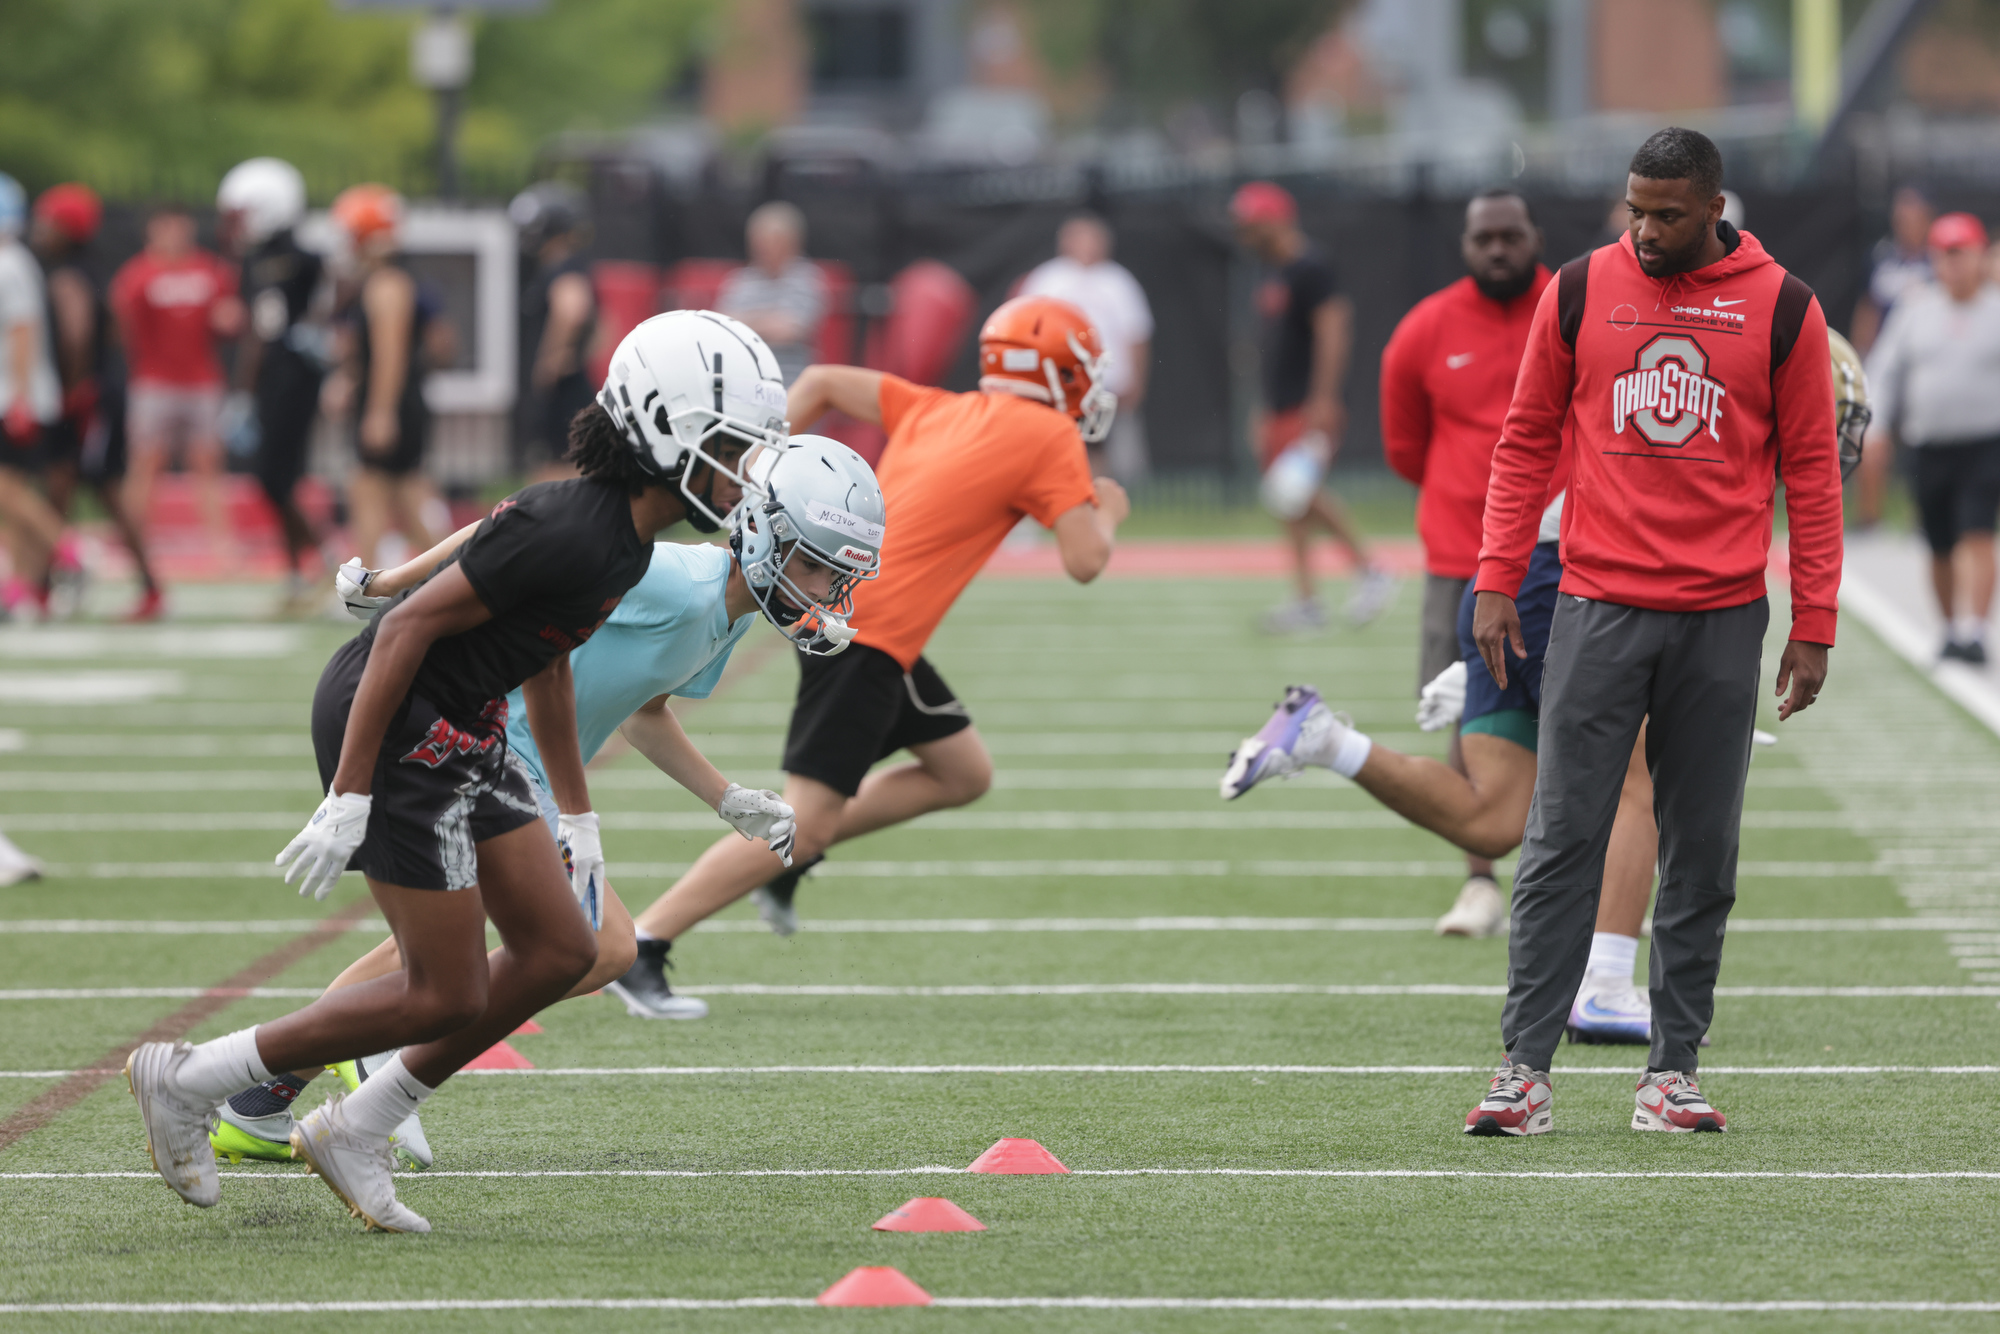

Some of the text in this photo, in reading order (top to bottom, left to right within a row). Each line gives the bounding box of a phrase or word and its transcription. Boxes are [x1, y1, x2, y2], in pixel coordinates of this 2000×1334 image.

[1674, 315, 1744, 329] BUCKEYES
[1702, 308, 1746, 322] STATE
[844, 549, 873, 563] Riddell
